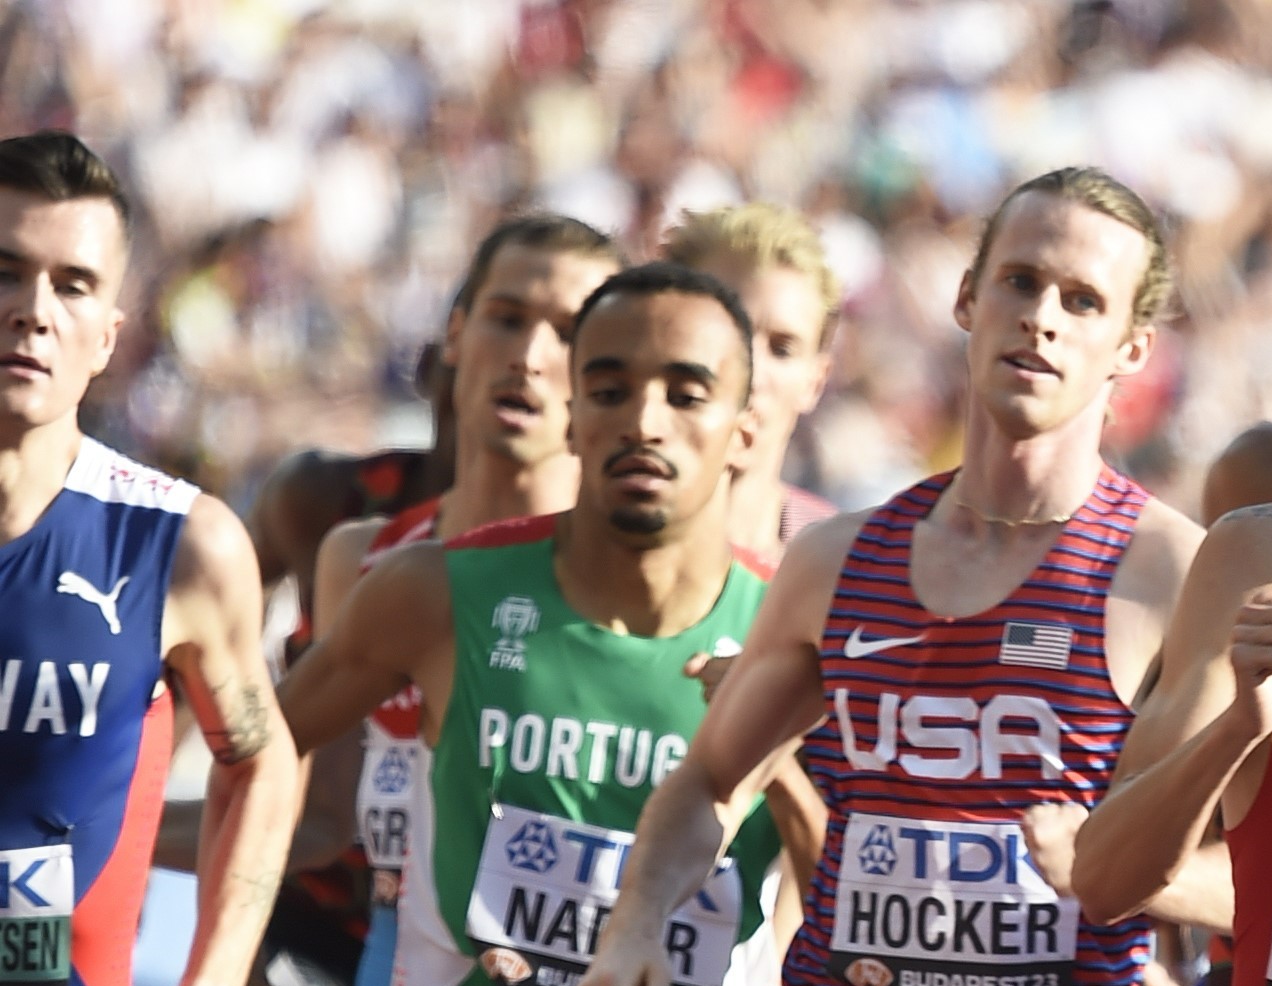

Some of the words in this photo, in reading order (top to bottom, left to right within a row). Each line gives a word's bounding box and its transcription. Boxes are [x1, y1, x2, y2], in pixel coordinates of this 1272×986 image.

[489, 651, 527, 672] FPA
[834, 688, 1063, 780] USA
[0, 921, 60, 971] SEN
[505, 886, 698, 978] NAR
[849, 890, 1060, 956] HOCKER
